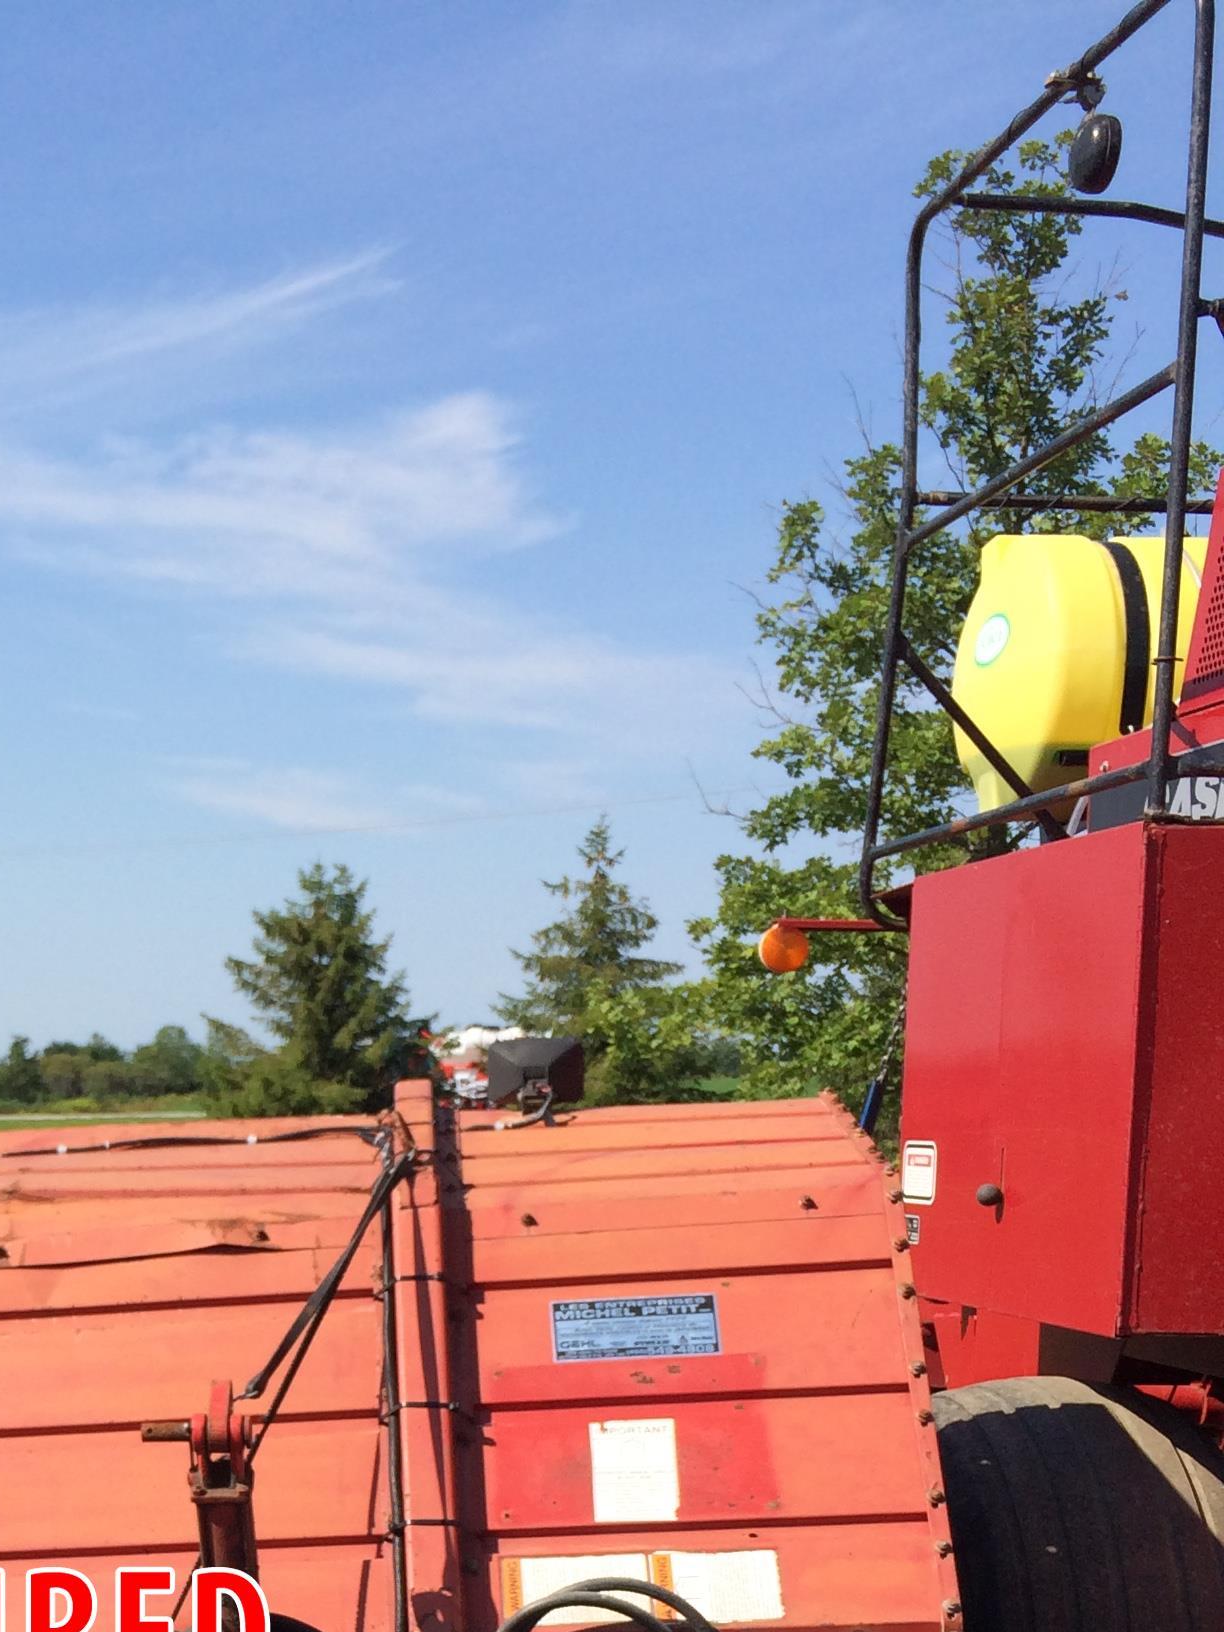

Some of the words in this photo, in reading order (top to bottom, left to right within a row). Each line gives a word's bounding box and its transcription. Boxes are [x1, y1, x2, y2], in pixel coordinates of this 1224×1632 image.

[555, 1305, 636, 1321] MICHEL
[642, 1303, 699, 1316] PETIT
[507, 1560, 520, 1610] WARNING
